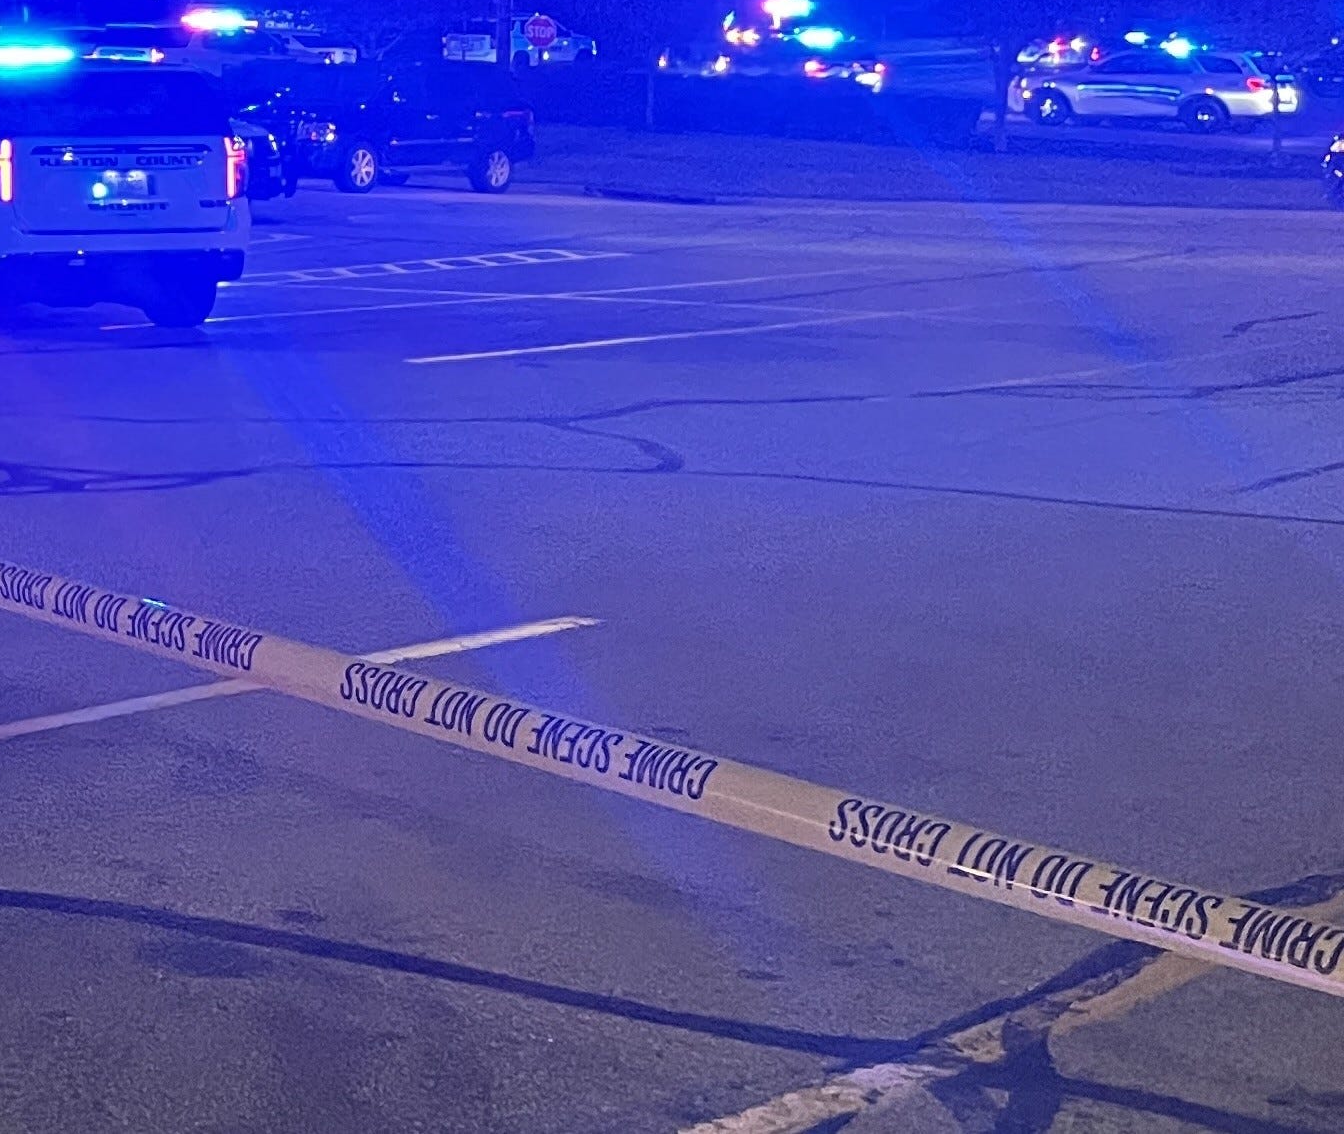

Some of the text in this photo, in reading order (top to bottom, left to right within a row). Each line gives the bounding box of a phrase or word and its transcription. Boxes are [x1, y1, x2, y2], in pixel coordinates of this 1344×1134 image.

[527, 25, 552, 39] STOP
[52, 581, 95, 624] NOT
[93, 594, 127, 633] DO
[126, 601, 196, 652] SCENE
[192, 621, 263, 671] CRIME
[339, 663, 719, 800] CRIME SCENE DO NOT CROSS
[828, 797, 1344, 975] CRIME SCENE DO NOT CROSS
